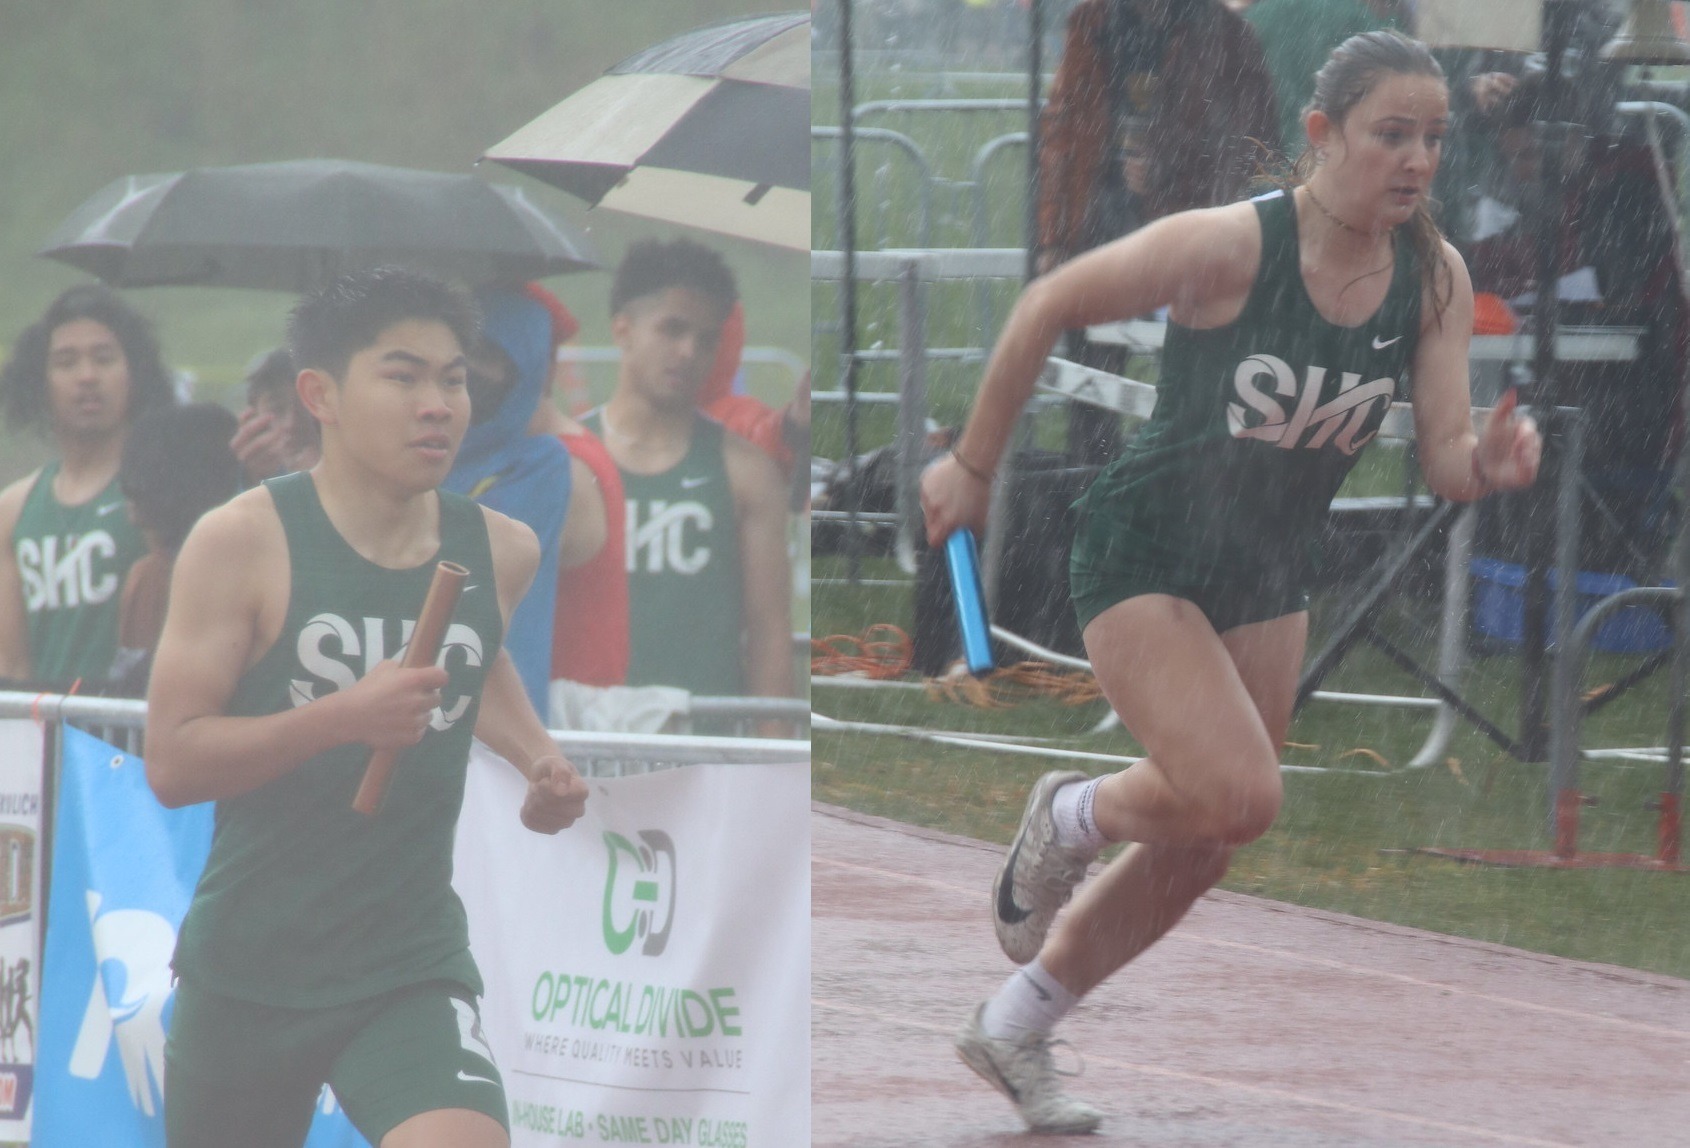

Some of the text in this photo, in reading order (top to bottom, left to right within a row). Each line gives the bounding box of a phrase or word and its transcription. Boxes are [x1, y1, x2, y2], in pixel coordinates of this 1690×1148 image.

[1226, 353, 1396, 456] SHC
[17, 529, 118, 612] SHC
[625, 499, 714, 574] HC
[523, 1032, 744, 1070] WHERE QUALITY MEETS VALUE
[557, 1104, 585, 1139] LAB
[596, 1113, 653, 1144] SAME
[654, 1116, 693, 1145] DAY
[697, 1117, 750, 1148] GLASSES
